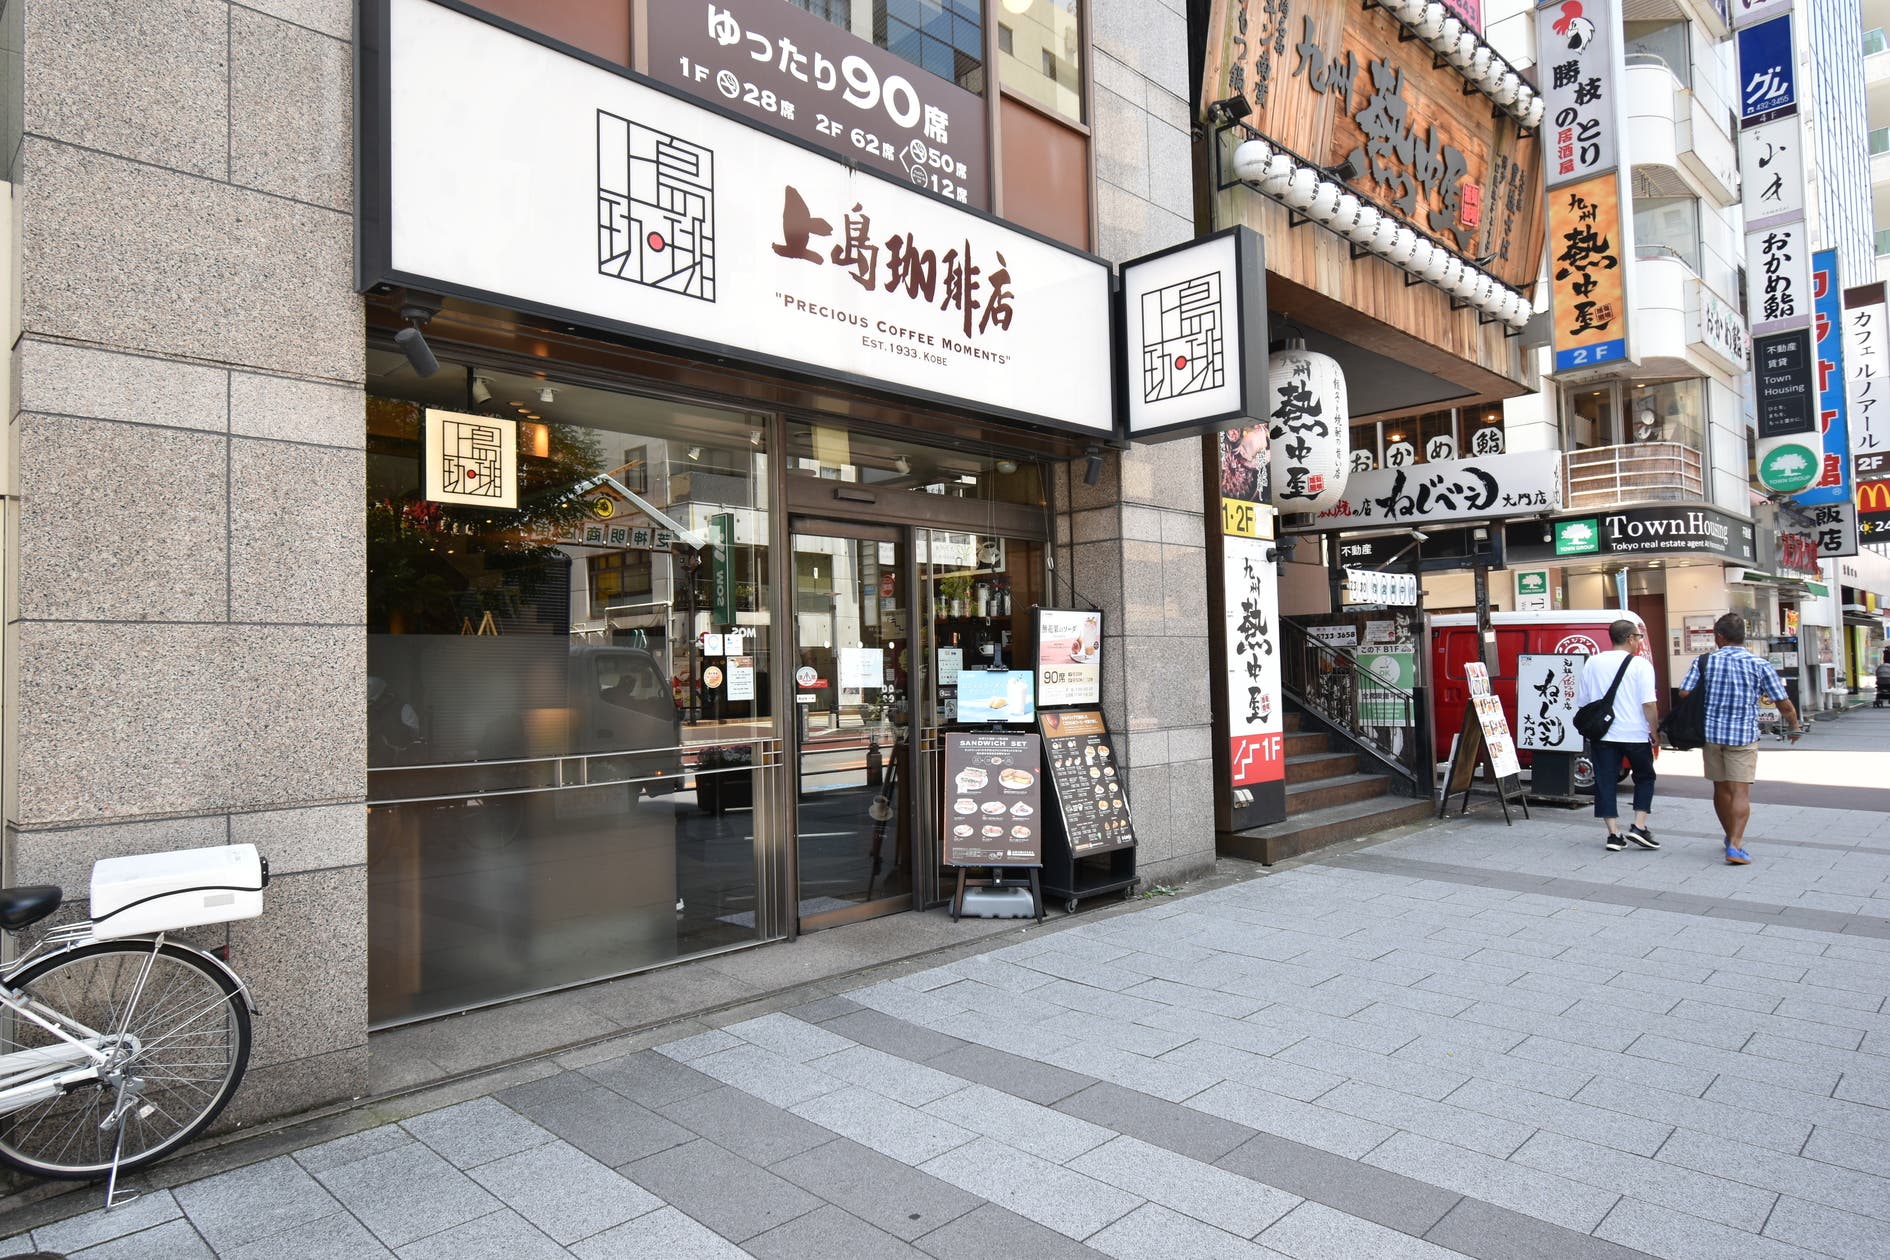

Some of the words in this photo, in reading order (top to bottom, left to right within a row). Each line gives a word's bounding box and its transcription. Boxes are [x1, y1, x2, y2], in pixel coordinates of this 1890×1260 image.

[707, 3, 949, 144] ゆったり90席
[679, 56, 710, 82] 1F
[743, 82, 795, 121] 28席
[816, 113, 844, 138] 2F
[851, 128, 895, 162] 62席
[928, 148, 968, 179] 50席
[1558, 127, 1575, 176] 居酒屋
[931, 173, 968, 204] 12席
[772, 185, 1014, 338] 上島珈琲店
[1762, 231, 1794, 321] おかめ鮨
[876, 320, 935, 347] COFFEE
[1573, 346, 1608, 365] 2F
[1766, 342, 1797, 355] 不動産
[1764, 374, 1791, 385] Town
[1764, 383, 1805, 397] Housing
[1853, 311, 1881, 450] カフェルノアール
[1858, 457, 1883, 471] 2F
[1502, 490, 1548, 507] 大門店
[1341, 544, 1372, 556] 不動産
[1611, 543, 1639, 551] Tokyo
[1641, 541, 1658, 549] real
[1044, 671, 1066, 684] 90席
[1262, 736, 1281, 762] 1F
